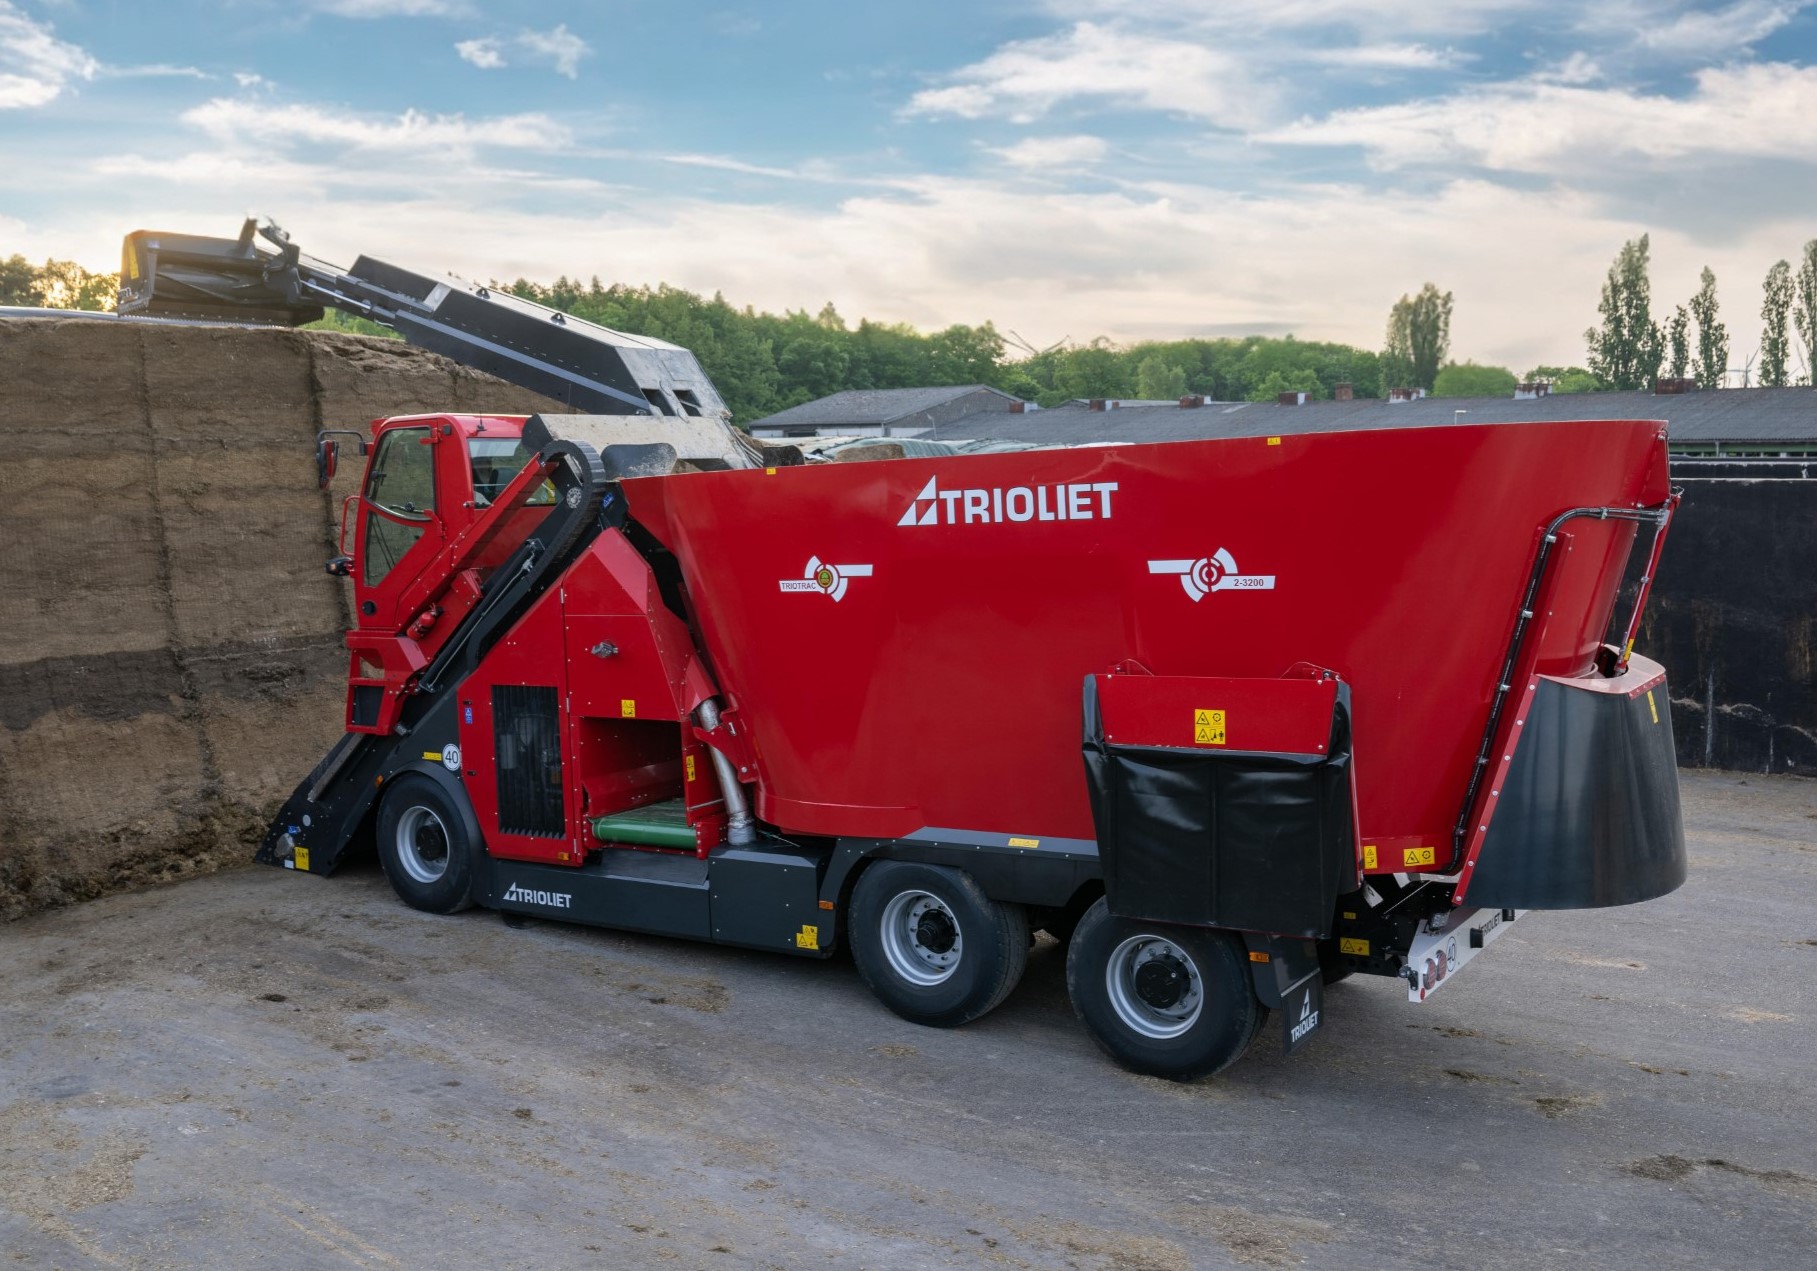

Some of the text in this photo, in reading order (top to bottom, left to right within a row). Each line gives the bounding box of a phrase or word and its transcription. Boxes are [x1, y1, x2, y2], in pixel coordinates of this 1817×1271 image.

[939, 482, 1119, 525] TRIOLIET
[781, 582, 816, 590] TRIOTRAC
[1234, 578, 1264, 587] 2-3200
[445, 750, 459, 764] 40
[516, 888, 572, 908] TRIOLIET
[1290, 1010, 1319, 1043] TRIOLIET
